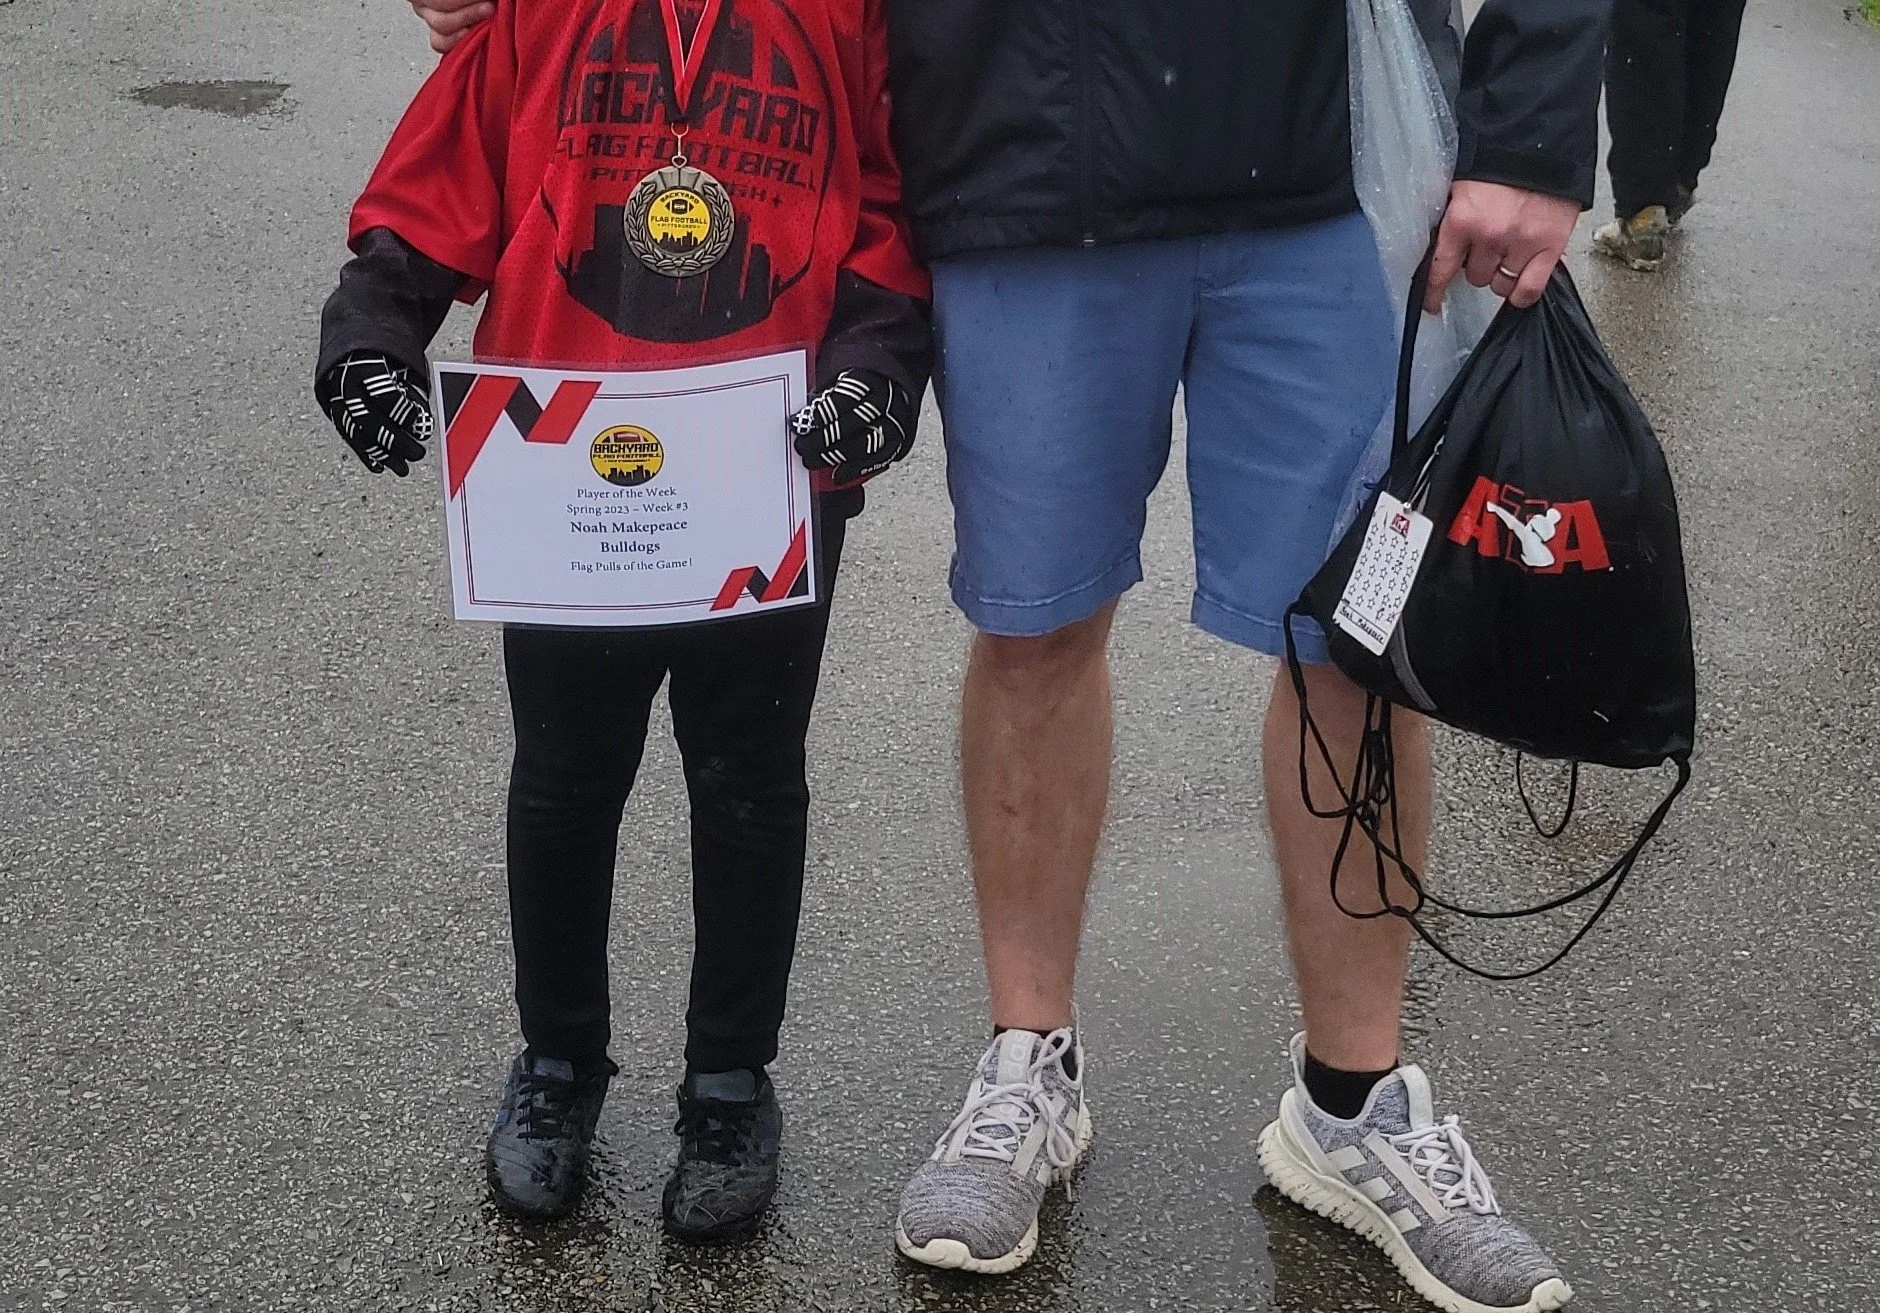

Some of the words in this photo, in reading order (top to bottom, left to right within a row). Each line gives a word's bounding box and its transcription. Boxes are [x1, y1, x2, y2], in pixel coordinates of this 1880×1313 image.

[566, 72, 819, 155] ACYARD
[670, 217, 708, 225] FOOTBALL
[593, 442, 659, 454] BACKYARD
[577, 488, 610, 501] Player
[612, 488, 625, 499] of
[626, 488, 643, 499] the
[645, 486, 677, 497] Week
[566, 503, 602, 517] Spring
[604, 505, 630, 514] 2023
[642, 502, 674, 513] Week
[675, 502, 689, 511] #3
[569, 521, 608, 533] Noah
[612, 521, 688, 535] Makepeace
[600, 541, 661, 555] Bulldogs
[570, 561, 593, 573] Flag
[595, 561, 621, 571] Pulls
[623, 561, 636, 571] of
[637, 561, 654, 570] the
[656, 557, 693, 570] Game!
